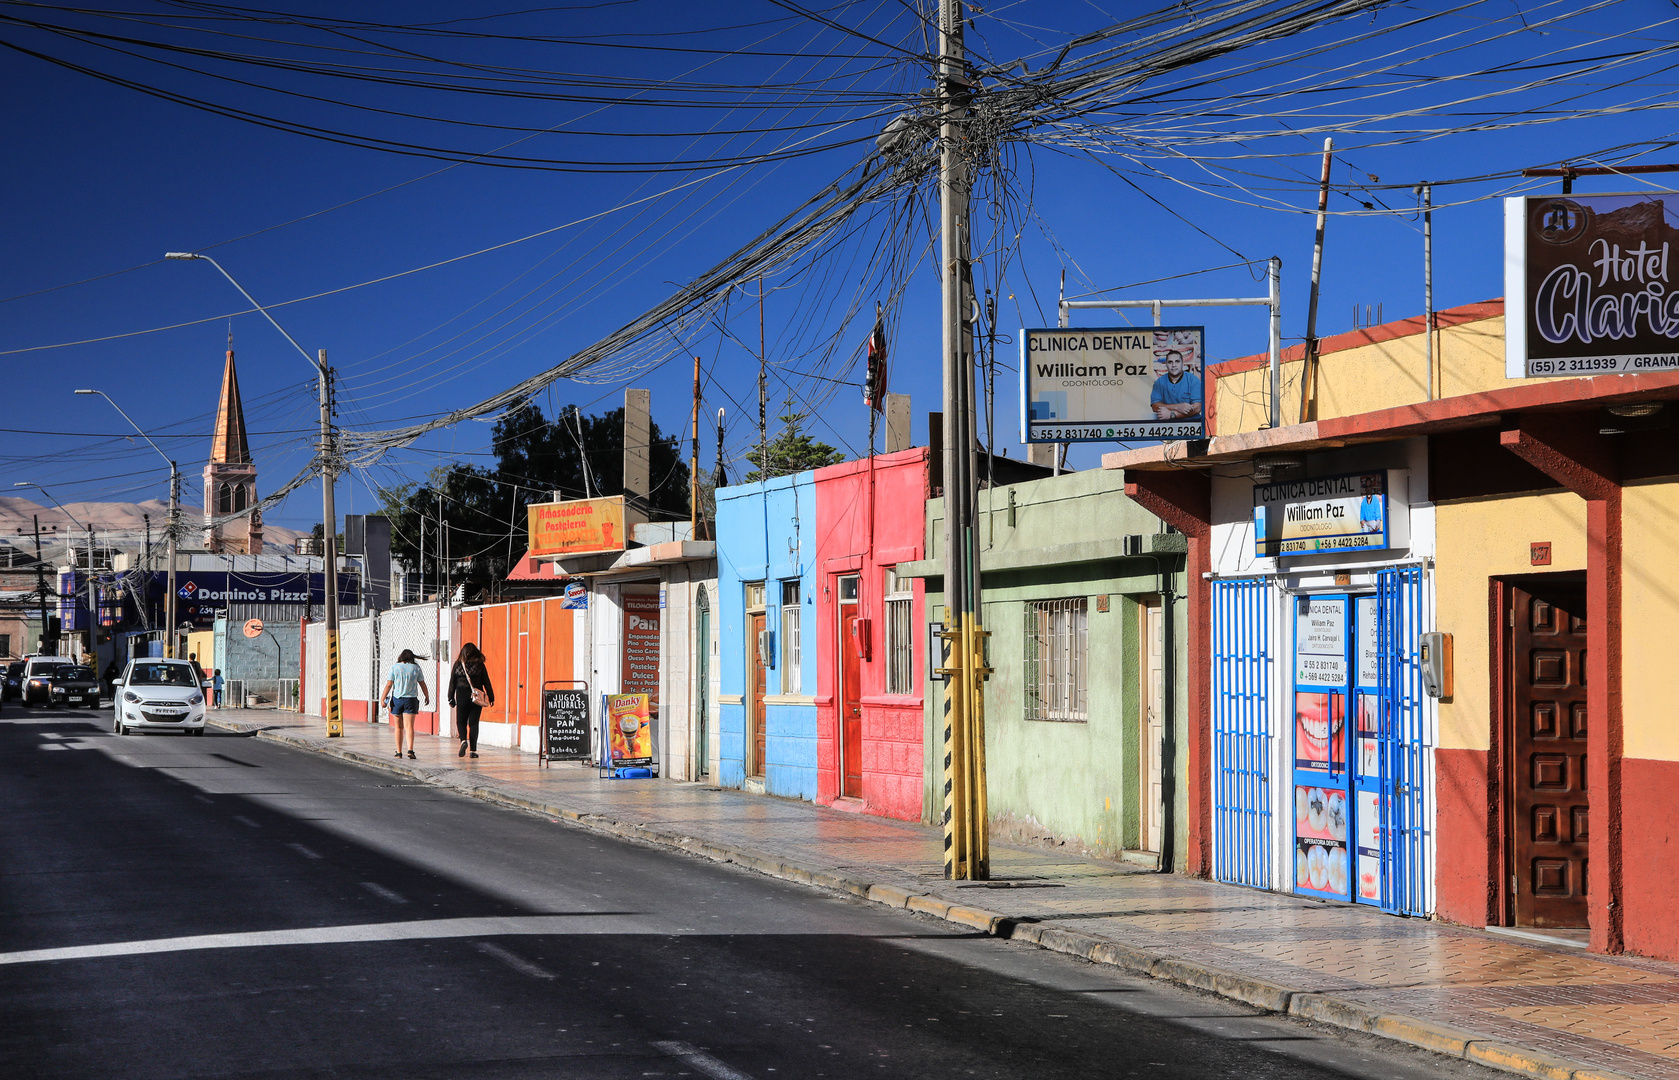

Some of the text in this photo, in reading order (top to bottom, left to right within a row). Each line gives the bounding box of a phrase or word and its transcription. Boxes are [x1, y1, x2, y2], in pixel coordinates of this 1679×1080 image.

[1588, 238, 1669, 288] Hotel
[1029, 335, 1150, 352] CLINICA DENTAL
[1037, 362, 1148, 377] William Paz
[1530, 361, 1555, 374] (55)
[1558, 360, 1566, 371] 2
[1569, 358, 1617, 370] 311939
[1634, 356, 1679, 368] GRANA
[1062, 378, 1124, 387] ODONTÓLOGO
[1040, 426, 1202, 439] 55 2 831740 +56 9 4422 5284
[1262, 477, 1354, 502] CLINICA DENTAL
[1287, 504, 1344, 522] William Paz
[1286, 541, 1306, 551] 831740
[1321, 539, 1331, 548] +56
[1338, 538, 1352, 547] 4422
[1354, 537, 1368, 546] 5284
[198, 588, 266, 600] Domino's
[1322, 605, 1341, 614] DENTAL
[630, 615, 658, 630] Pan
[1309, 660, 1315, 669] 55
[1320, 661, 1338, 670] 831740
[1318, 673, 1330, 682] 4422
[1331, 674, 1344, 682] 5284
[548, 700, 585, 709] NATURALES
[614, 696, 642, 708] Danky
